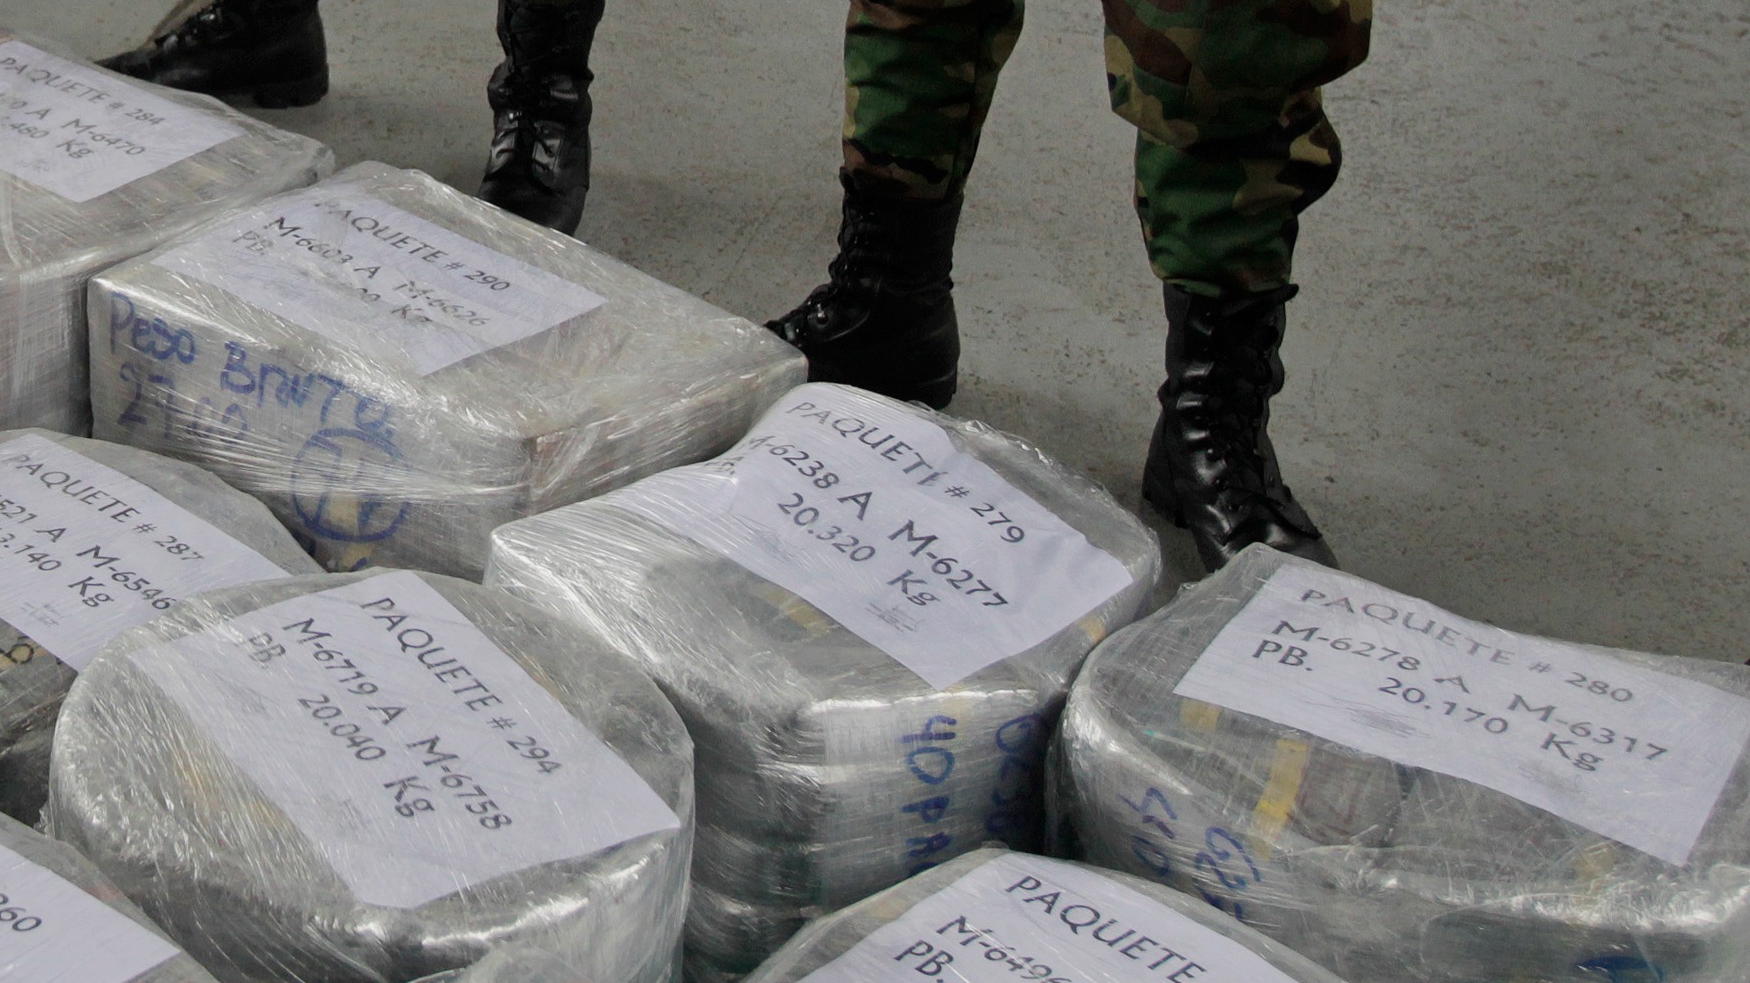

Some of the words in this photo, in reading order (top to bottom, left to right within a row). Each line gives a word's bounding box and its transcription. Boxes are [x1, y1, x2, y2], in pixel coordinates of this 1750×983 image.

[29, 105, 51, 121] A
[59, 117, 147, 157] M-6470
[55, 137, 95, 160] Kg
[110, 97, 124, 112] #
[124, 106, 167, 127] 284
[353, 262, 383, 280] A
[444, 259, 463, 274] #
[463, 268, 512, 293] 290
[2, 454, 141, 524] PAQUETE
[133, 521, 159, 536] #
[152, 534, 205, 563] 287
[776, 491, 877, 563] 20.320
[886, 569, 942, 608] Kg
[836, 488, 877, 521] A
[887, 519, 1010, 610] M-6277
[944, 484, 971, 500] #
[969, 501, 1028, 545] 279
[36, 525, 68, 544] A
[75, 543, 177, 611] M-6546
[67, 575, 115, 609] Kg
[359, 597, 503, 713] PAQUETE
[486, 714, 517, 731] #
[506, 735, 562, 775] 294
[1270, 620, 1421, 672] M-6278
[1432, 674, 1471, 694] A
[1507, 693, 1668, 763] M-6317
[1300, 588, 1517, 666] PAQUETE
[1529, 659, 1551, 674] #
[1563, 671, 1635, 704] 280
[281, 618, 380, 698] M-6719
[366, 703, 408, 726] A
[406, 735, 513, 831] M-6758
[297, 693, 387, 762] 20.040
[382, 775, 435, 818] Kg
[1252, 640, 1313, 672] PB.
[1377, 677, 1509, 737] 20.170
[1539, 734, 1605, 772] Kg
[1005, 874, 1208, 983] PAQUETE
